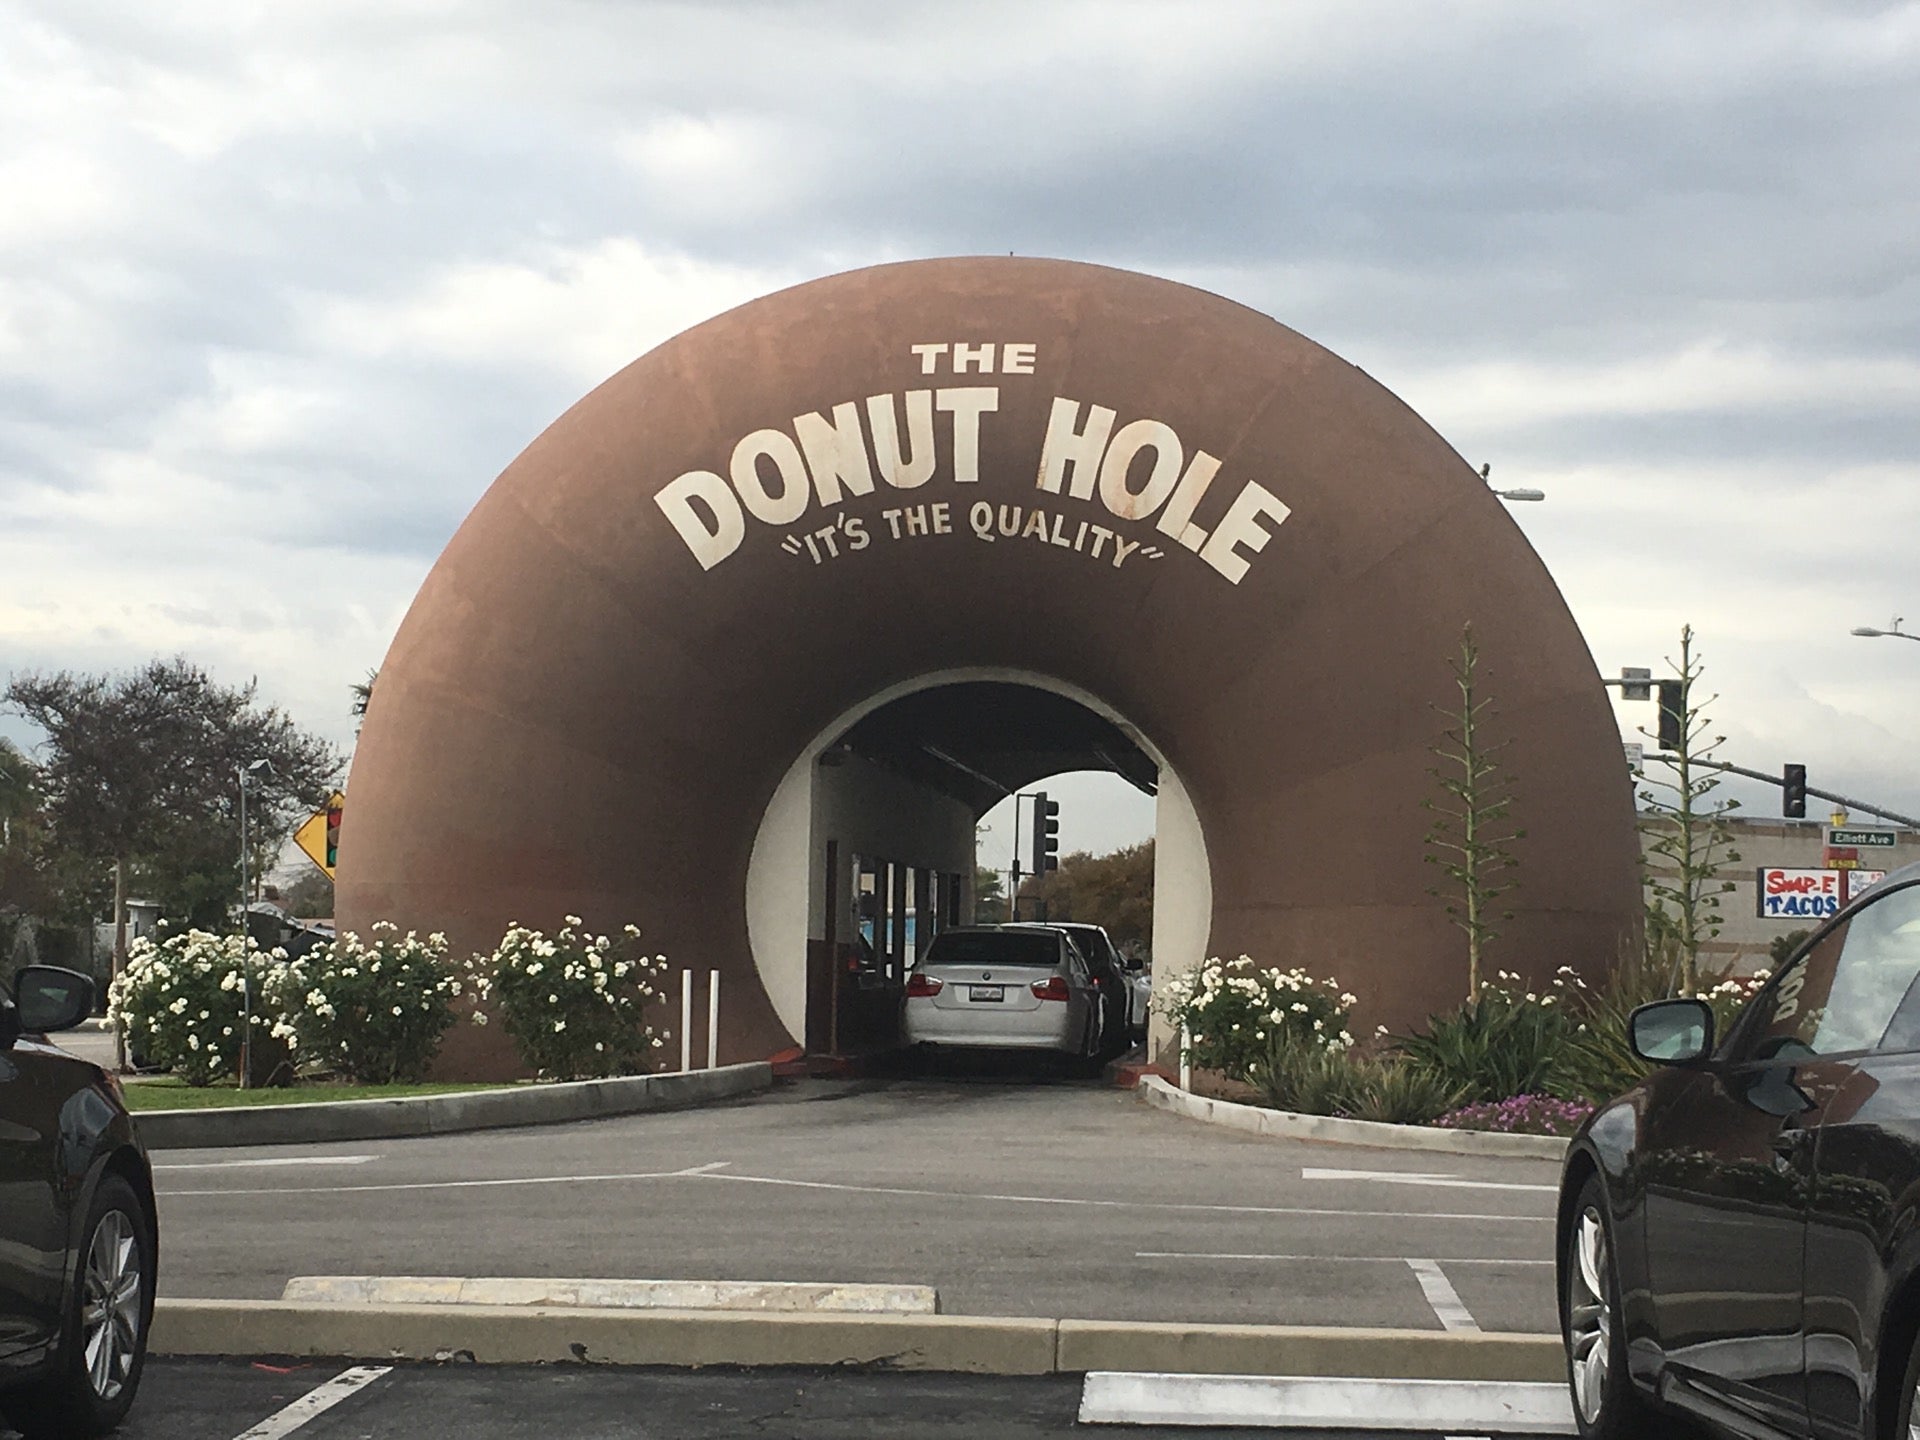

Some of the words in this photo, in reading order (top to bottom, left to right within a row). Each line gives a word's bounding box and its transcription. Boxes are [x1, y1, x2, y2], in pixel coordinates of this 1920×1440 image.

[911, 342, 1037, 375] THE
[653, 386, 999, 572] DONUT
[1036, 396, 1292, 585] HOLE
[781, 512, 870, 564] "IT'S
[882, 502, 952, 539] THE
[970, 501, 1165, 568] QUALITY"
[1868, 834, 1891, 844] Ave
[1765, 895, 1838, 916] TACOS
